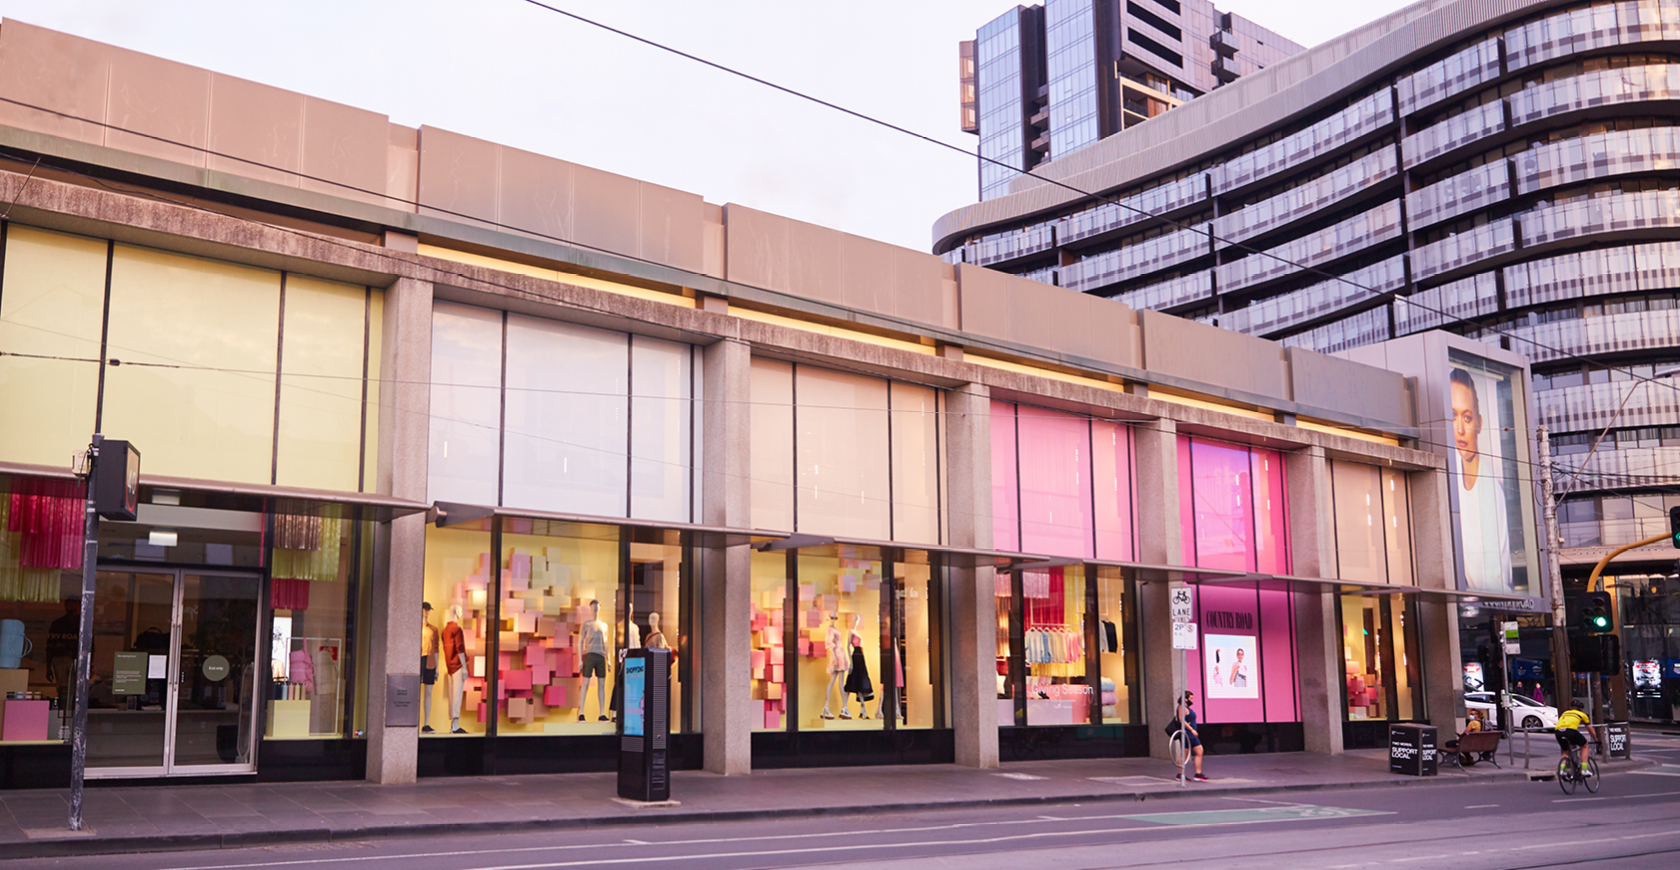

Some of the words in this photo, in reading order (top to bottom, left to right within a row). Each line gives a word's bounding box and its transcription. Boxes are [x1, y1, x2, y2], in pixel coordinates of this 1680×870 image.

[1172, 608, 1190, 616] LANE
[1206, 610, 1234, 628] COUNTRY
[1235, 612, 1253, 629] ROAD
[1174, 623, 1184, 631] 2P
[1031, 683, 1060, 697] Giving
[1061, 683, 1094, 695] Season
